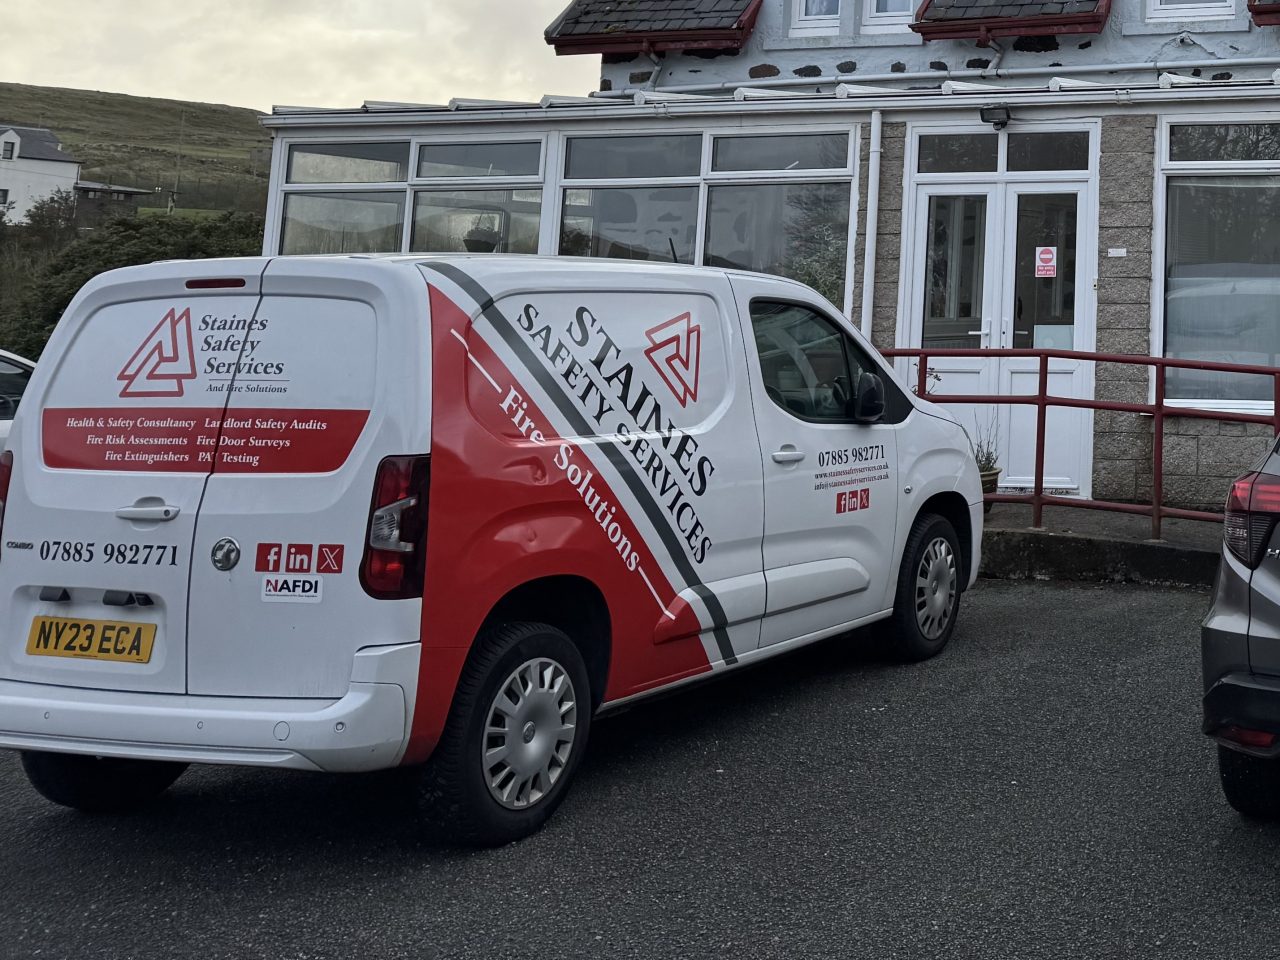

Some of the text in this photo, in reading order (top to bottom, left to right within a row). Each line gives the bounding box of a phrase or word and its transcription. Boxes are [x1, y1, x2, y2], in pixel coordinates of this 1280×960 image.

[198, 314, 269, 331] Staines
[200, 334, 262, 358] Safety
[203, 356, 285, 375] Services
[206, 384, 224, 392] And
[245, 384, 288, 394] Solutions
[566, 307, 714, 497] STAINES
[66, 417, 197, 431] Health & Safety Consultancy
[254, 418, 288, 432] Safety
[290, 419, 327, 430] Audits
[86, 434, 188, 446] Fire Risk Assessments
[196, 435, 291, 450] Fire Door Surveys
[516, 304, 712, 564] SAFETY SERVICES
[105, 451, 189, 464] Fire Extinguishers
[222, 453, 260, 467] Testing
[818, 444, 885, 467] 07885 982771
[499, 385, 641, 572] Fire Solutions
[39, 540, 178, 566] 07885 982771
[265, 579, 319, 593] NAFDI
[35, 621, 143, 656] NY23 ECA
